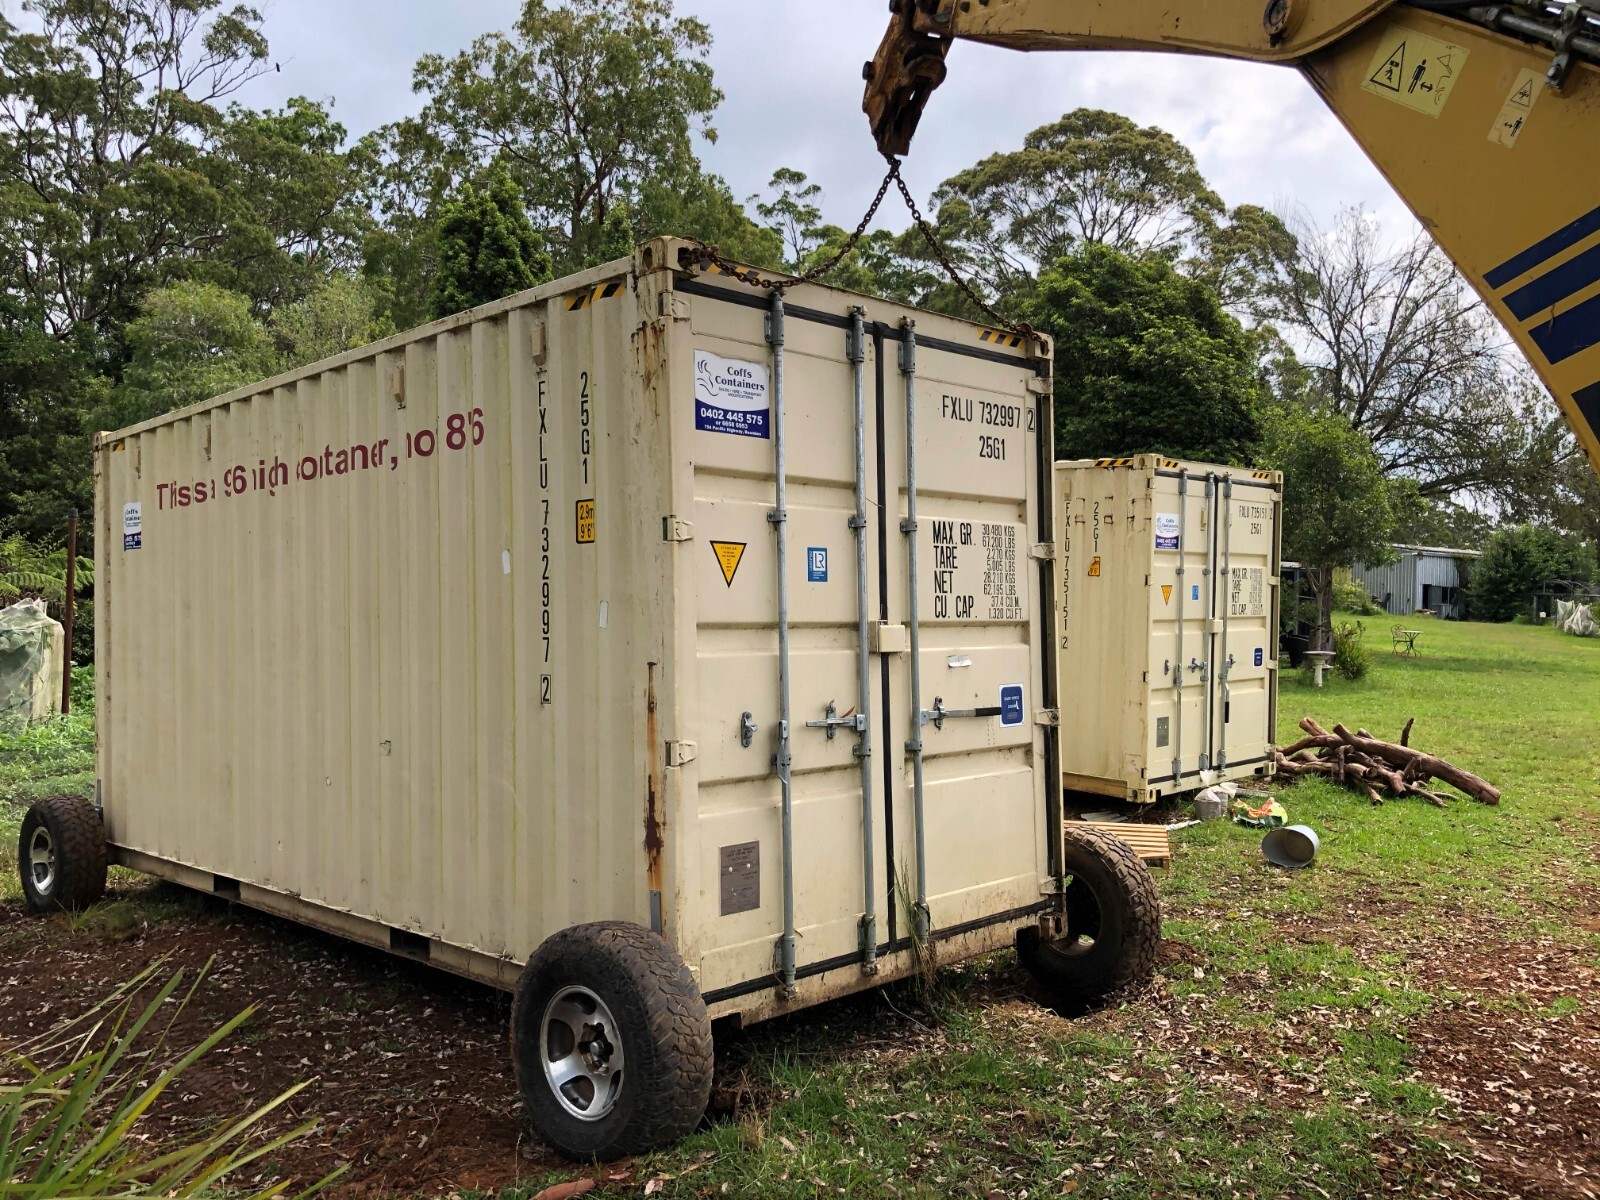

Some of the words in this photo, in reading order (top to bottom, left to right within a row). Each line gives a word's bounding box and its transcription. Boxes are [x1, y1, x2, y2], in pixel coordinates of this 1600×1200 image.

[727, 366, 752, 378] Coffs
[715, 375, 765, 391] Containers
[700, 408, 724, 420] 0402
[726, 412, 744, 422] 445
[746, 415, 763, 425] 575
[942, 394, 973, 422] FXLU
[978, 401, 1021, 429] 732997
[538, 380, 548, 489] FXLU
[580, 371, 590, 484] 25G1
[979, 436, 1006, 460] 25G1
[959, 523, 977, 546] GR.
[1004, 525, 1015, 538] KGS
[1004, 537, 1015, 549] LBS
[934, 545, 958, 569] TARE
[1004, 549, 1015, 561] KGS
[1004, 560, 1015, 573] LBS
[934, 571, 954, 594] NET
[1004, 572, 1016, 584] KGS
[1005, 584, 1016, 596] LBS
[934, 595, 951, 619] CU.
[955, 596, 978, 619] CAP.
